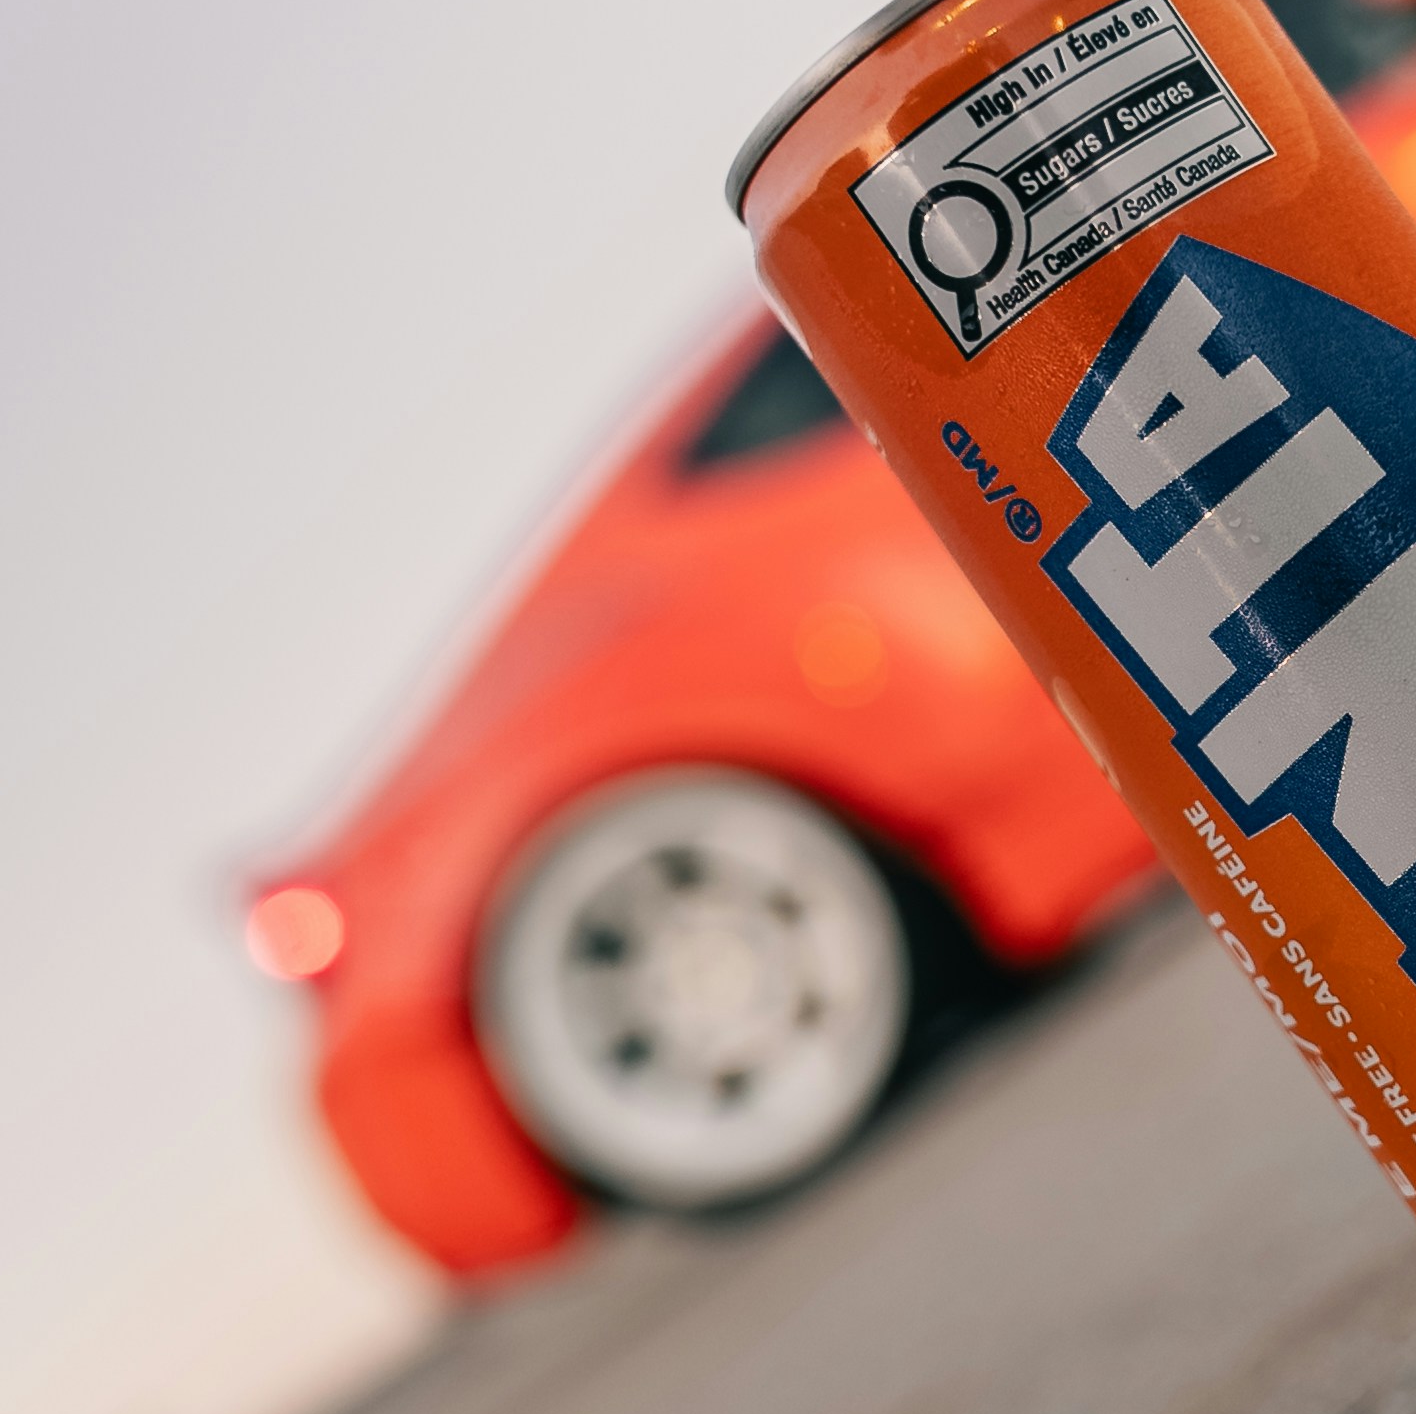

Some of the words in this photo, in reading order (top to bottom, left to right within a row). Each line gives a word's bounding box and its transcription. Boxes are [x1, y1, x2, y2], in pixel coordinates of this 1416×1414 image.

[965, 81, 1028, 128] High
[1066, 14, 1130, 62] Élevé
[1131, 5, 1160, 30] en
[1018, 133, 1102, 196] Sugars
[1103, 117, 1115, 143] /
[1117, 81, 1194, 131] Sucres
[986, 268, 1047, 320] Health
[1043, 221, 1115, 276] Canada
[1113, 207, 1124, 231] /
[1122, 175, 1178, 221] Santé
[1175, 143, 1241, 188] Canada
[1183, 800, 1287, 938] CAFÉINE
[1281, 939, 1352, 1028] SANS
